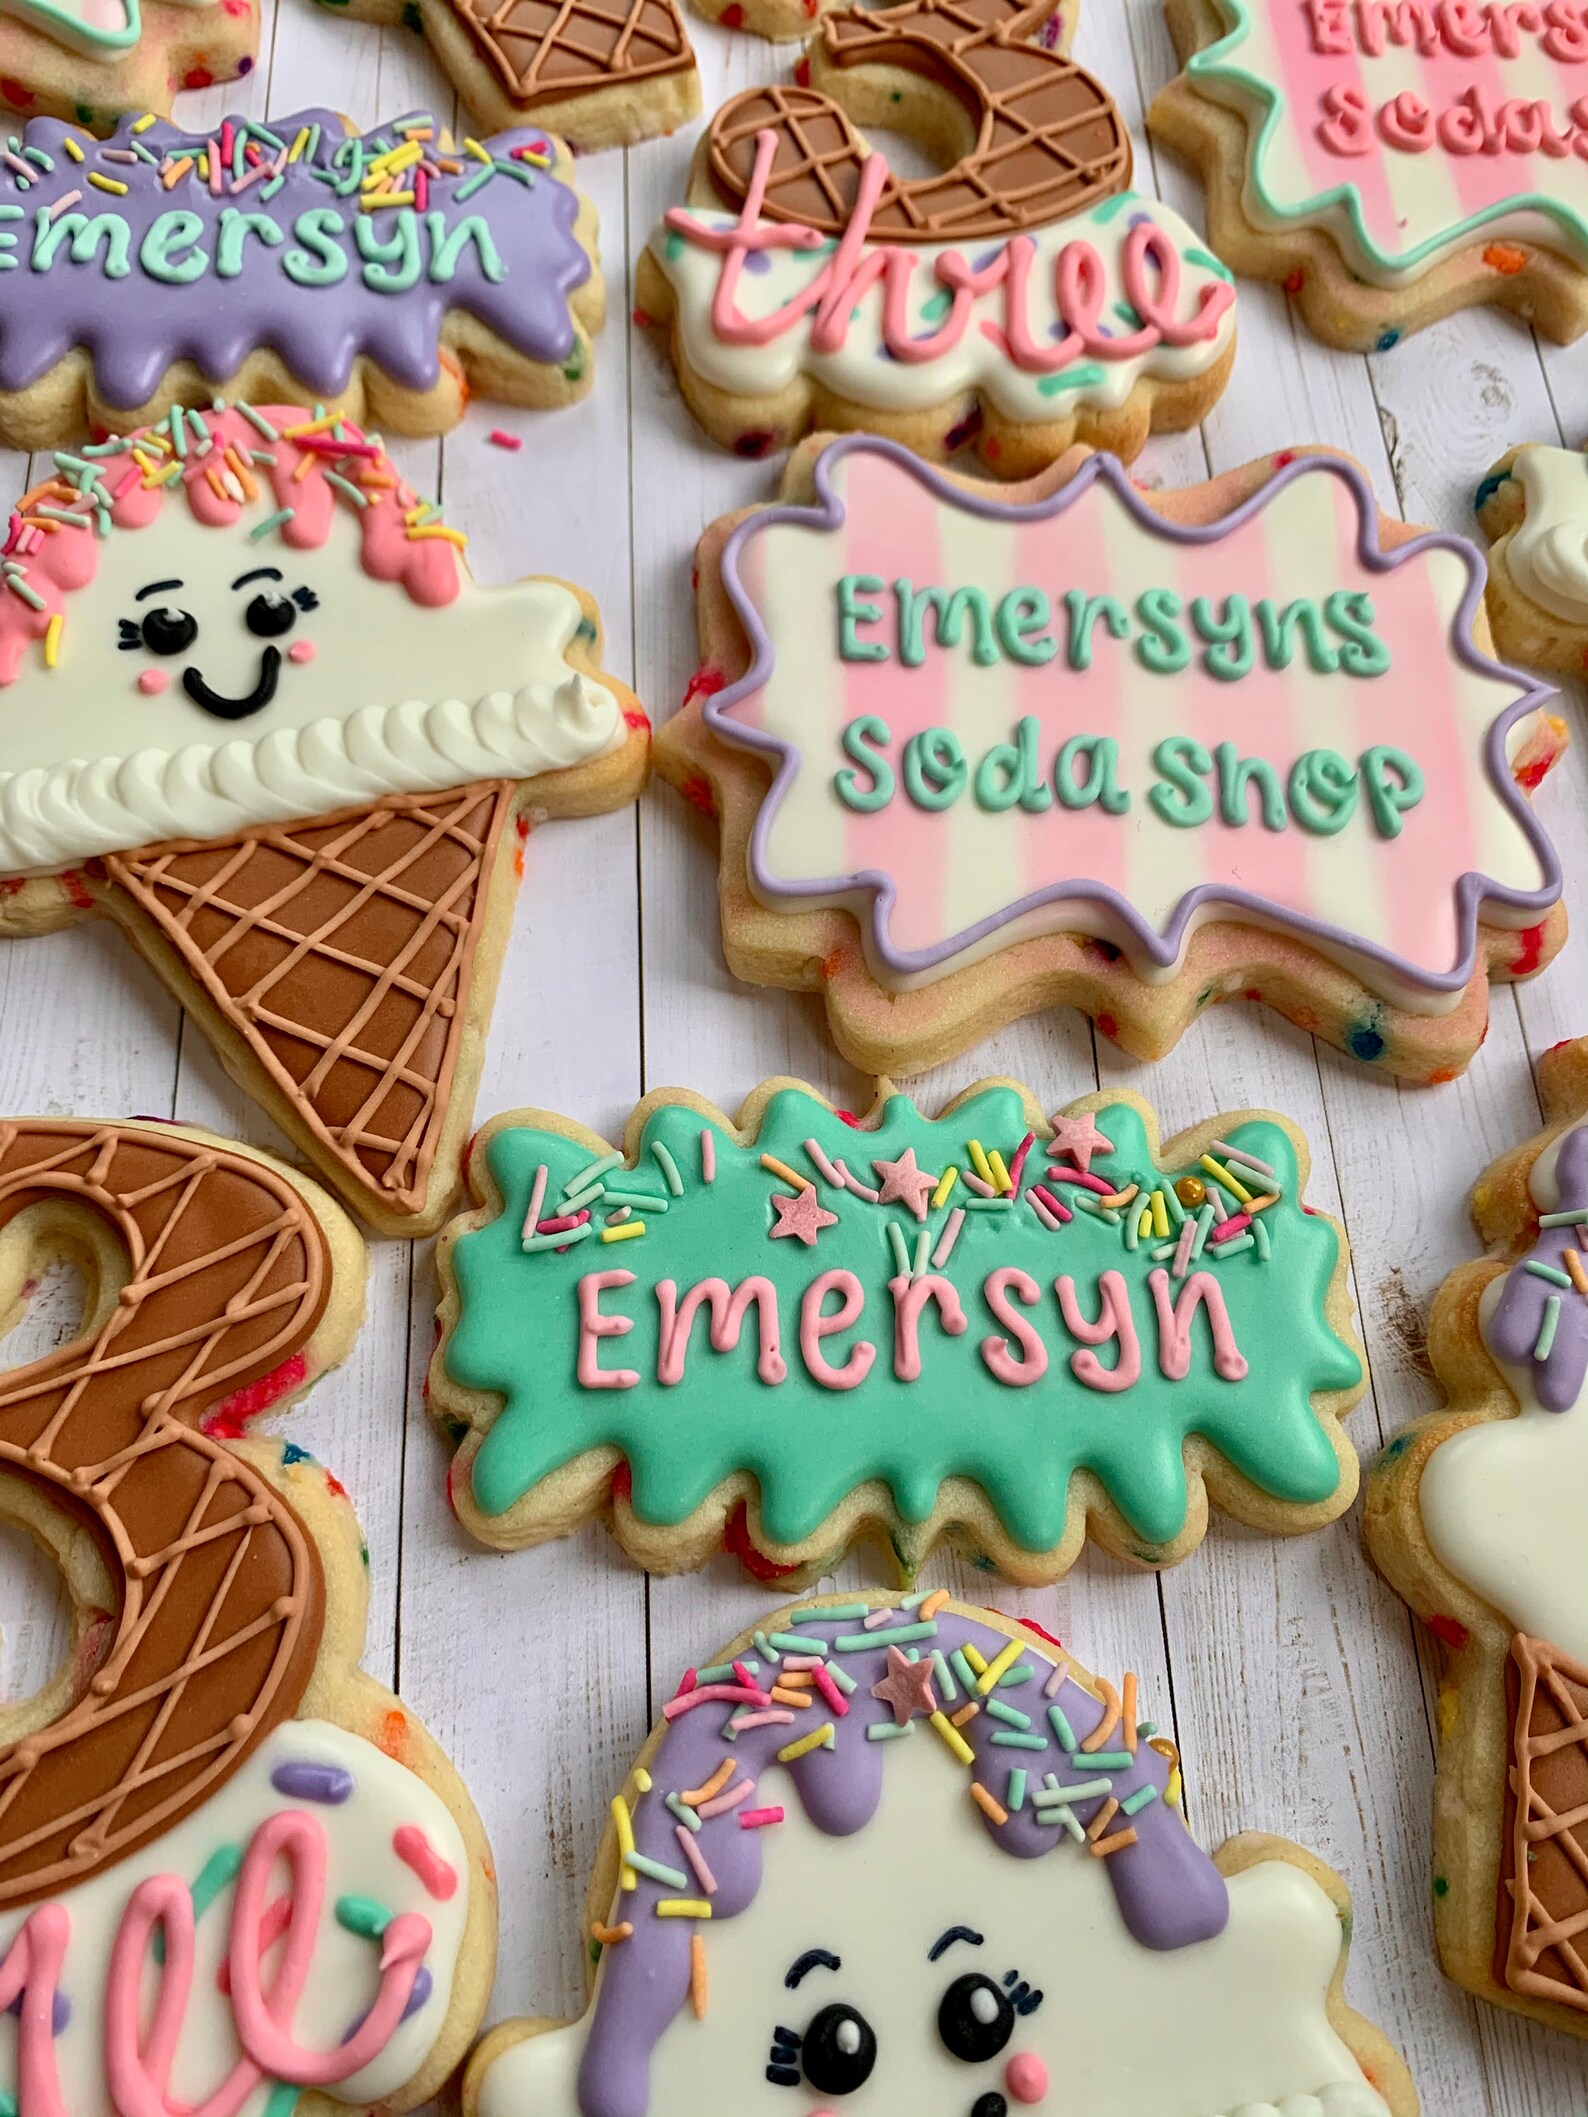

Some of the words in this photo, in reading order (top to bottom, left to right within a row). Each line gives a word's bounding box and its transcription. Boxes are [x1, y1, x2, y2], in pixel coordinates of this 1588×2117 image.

[1305, 0, 1588, 64] Emers
[1316, 83, 1574, 158] Soda
[664, 129, 1237, 373] three
[835, 574, 1391, 682] Emersyns
[834, 715, 1131, 814] Soda
[1148, 735, 1425, 840] Shop
[577, 1267, 1250, 1393] Emersyn
